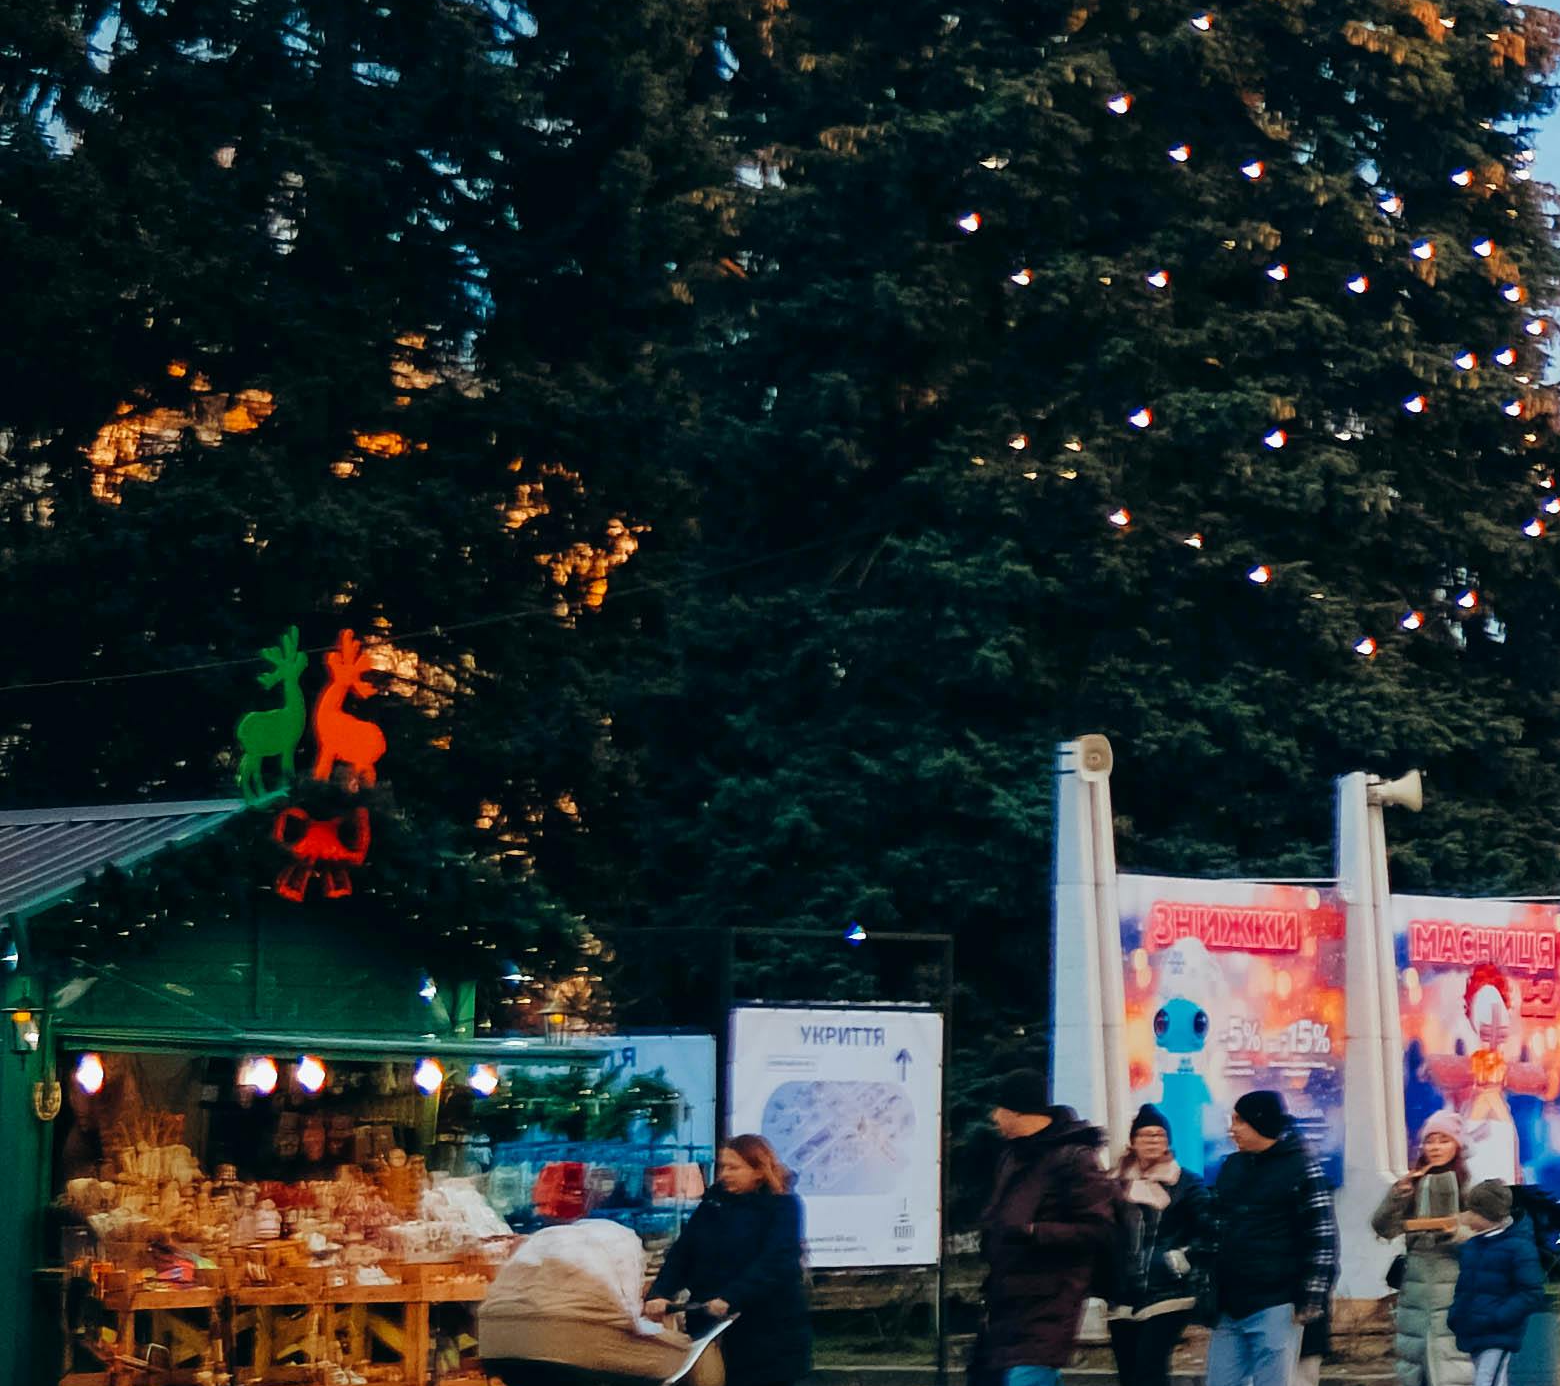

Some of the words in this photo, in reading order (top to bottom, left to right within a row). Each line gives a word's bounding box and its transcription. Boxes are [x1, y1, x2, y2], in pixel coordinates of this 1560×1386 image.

[1153, 902, 1299, 951] ЗНИЖКИ
[1411, 923, 1556, 974] МАСНИЦЯ
[800, 1025, 885, 1045] УКРИТТЯ
